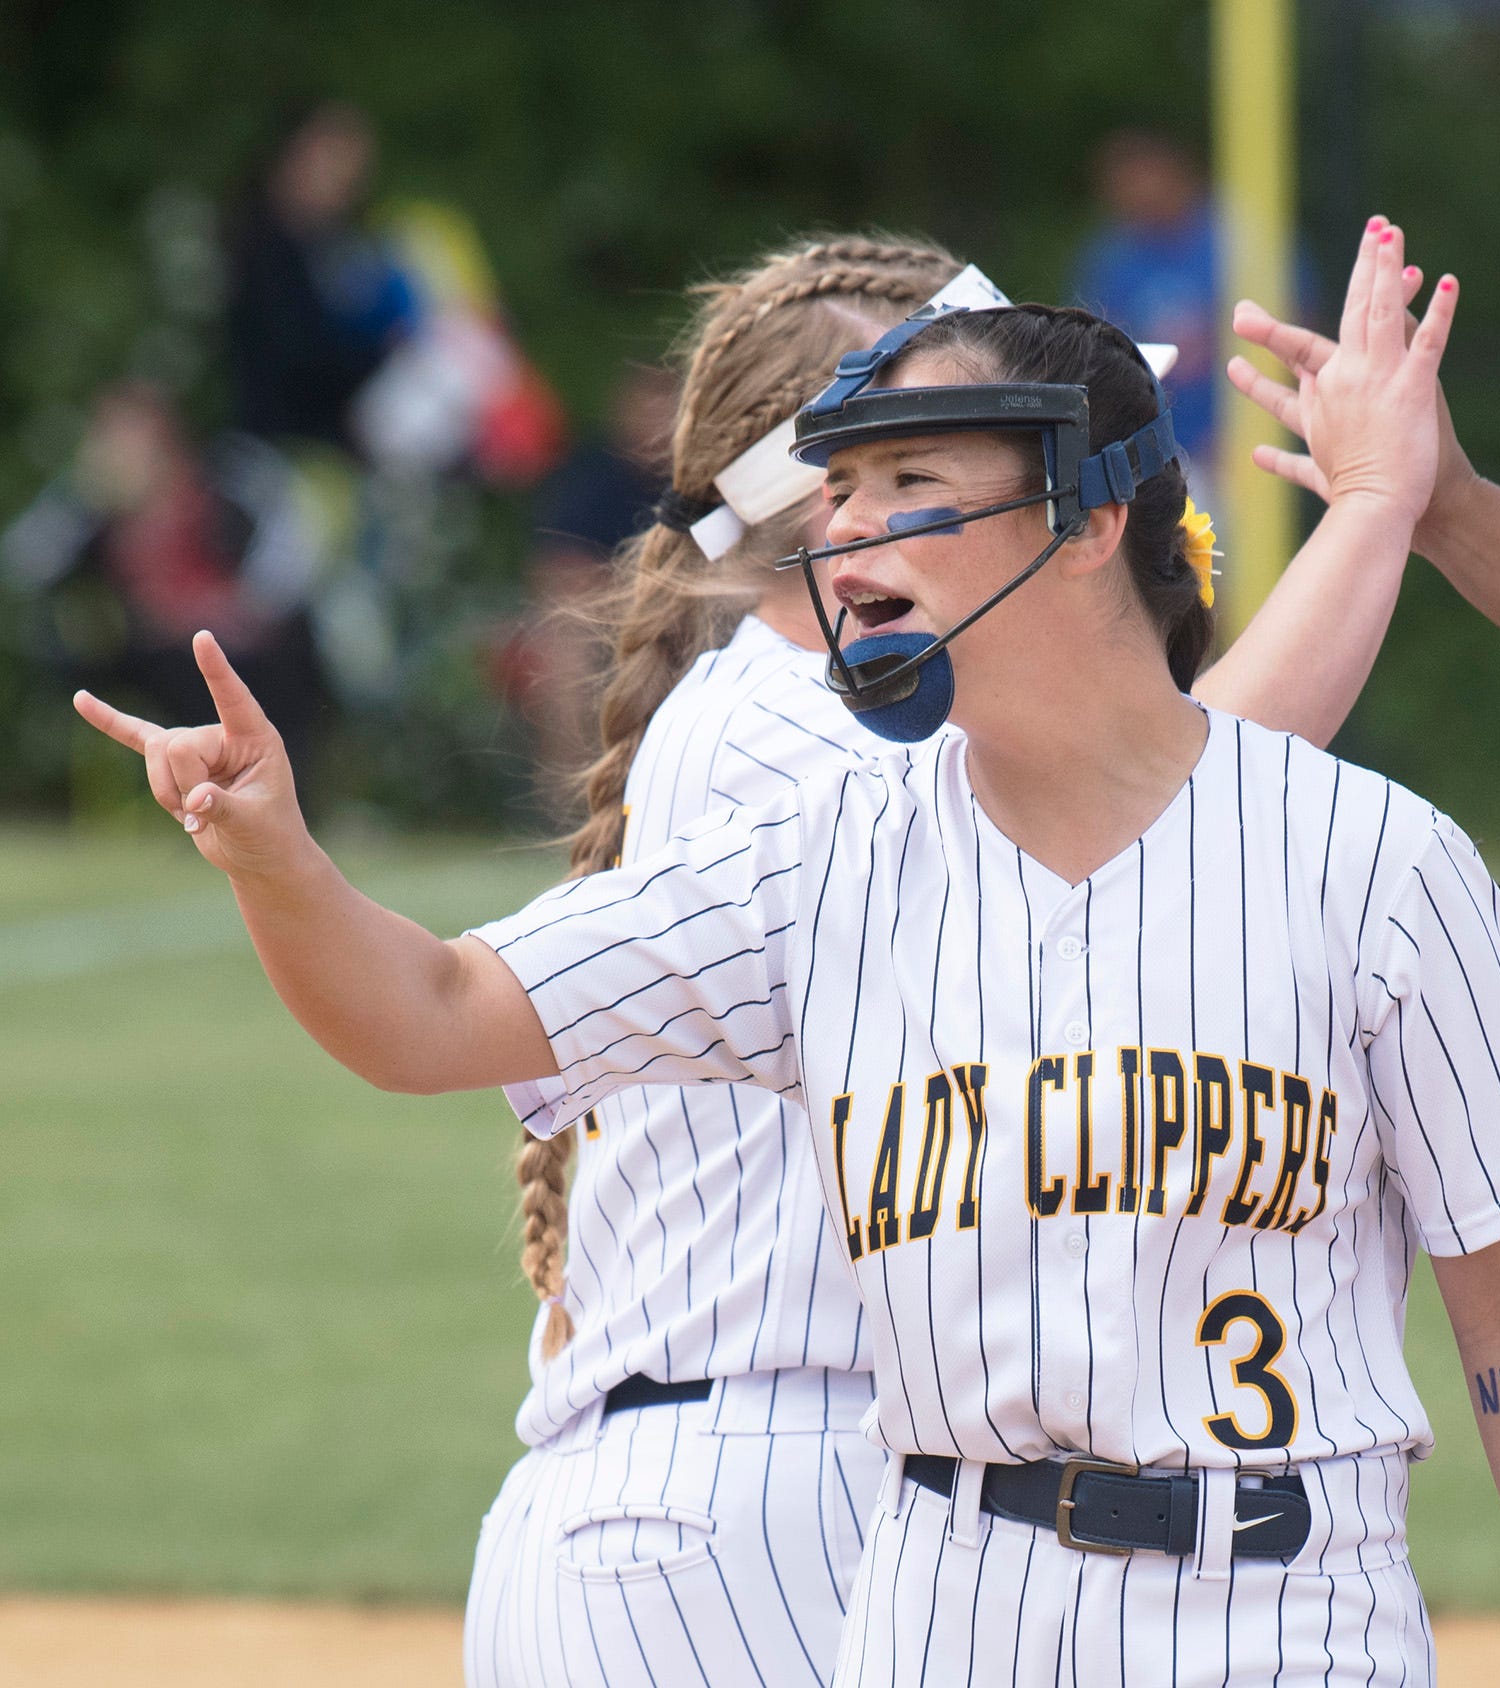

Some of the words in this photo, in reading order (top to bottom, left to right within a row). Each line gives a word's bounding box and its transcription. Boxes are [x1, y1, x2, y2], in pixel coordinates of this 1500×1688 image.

[832, 1062, 990, 1263] LADY
[1024, 1045, 1338, 1237] CLIPPERS
[1195, 1289, 1299, 1450] 3
